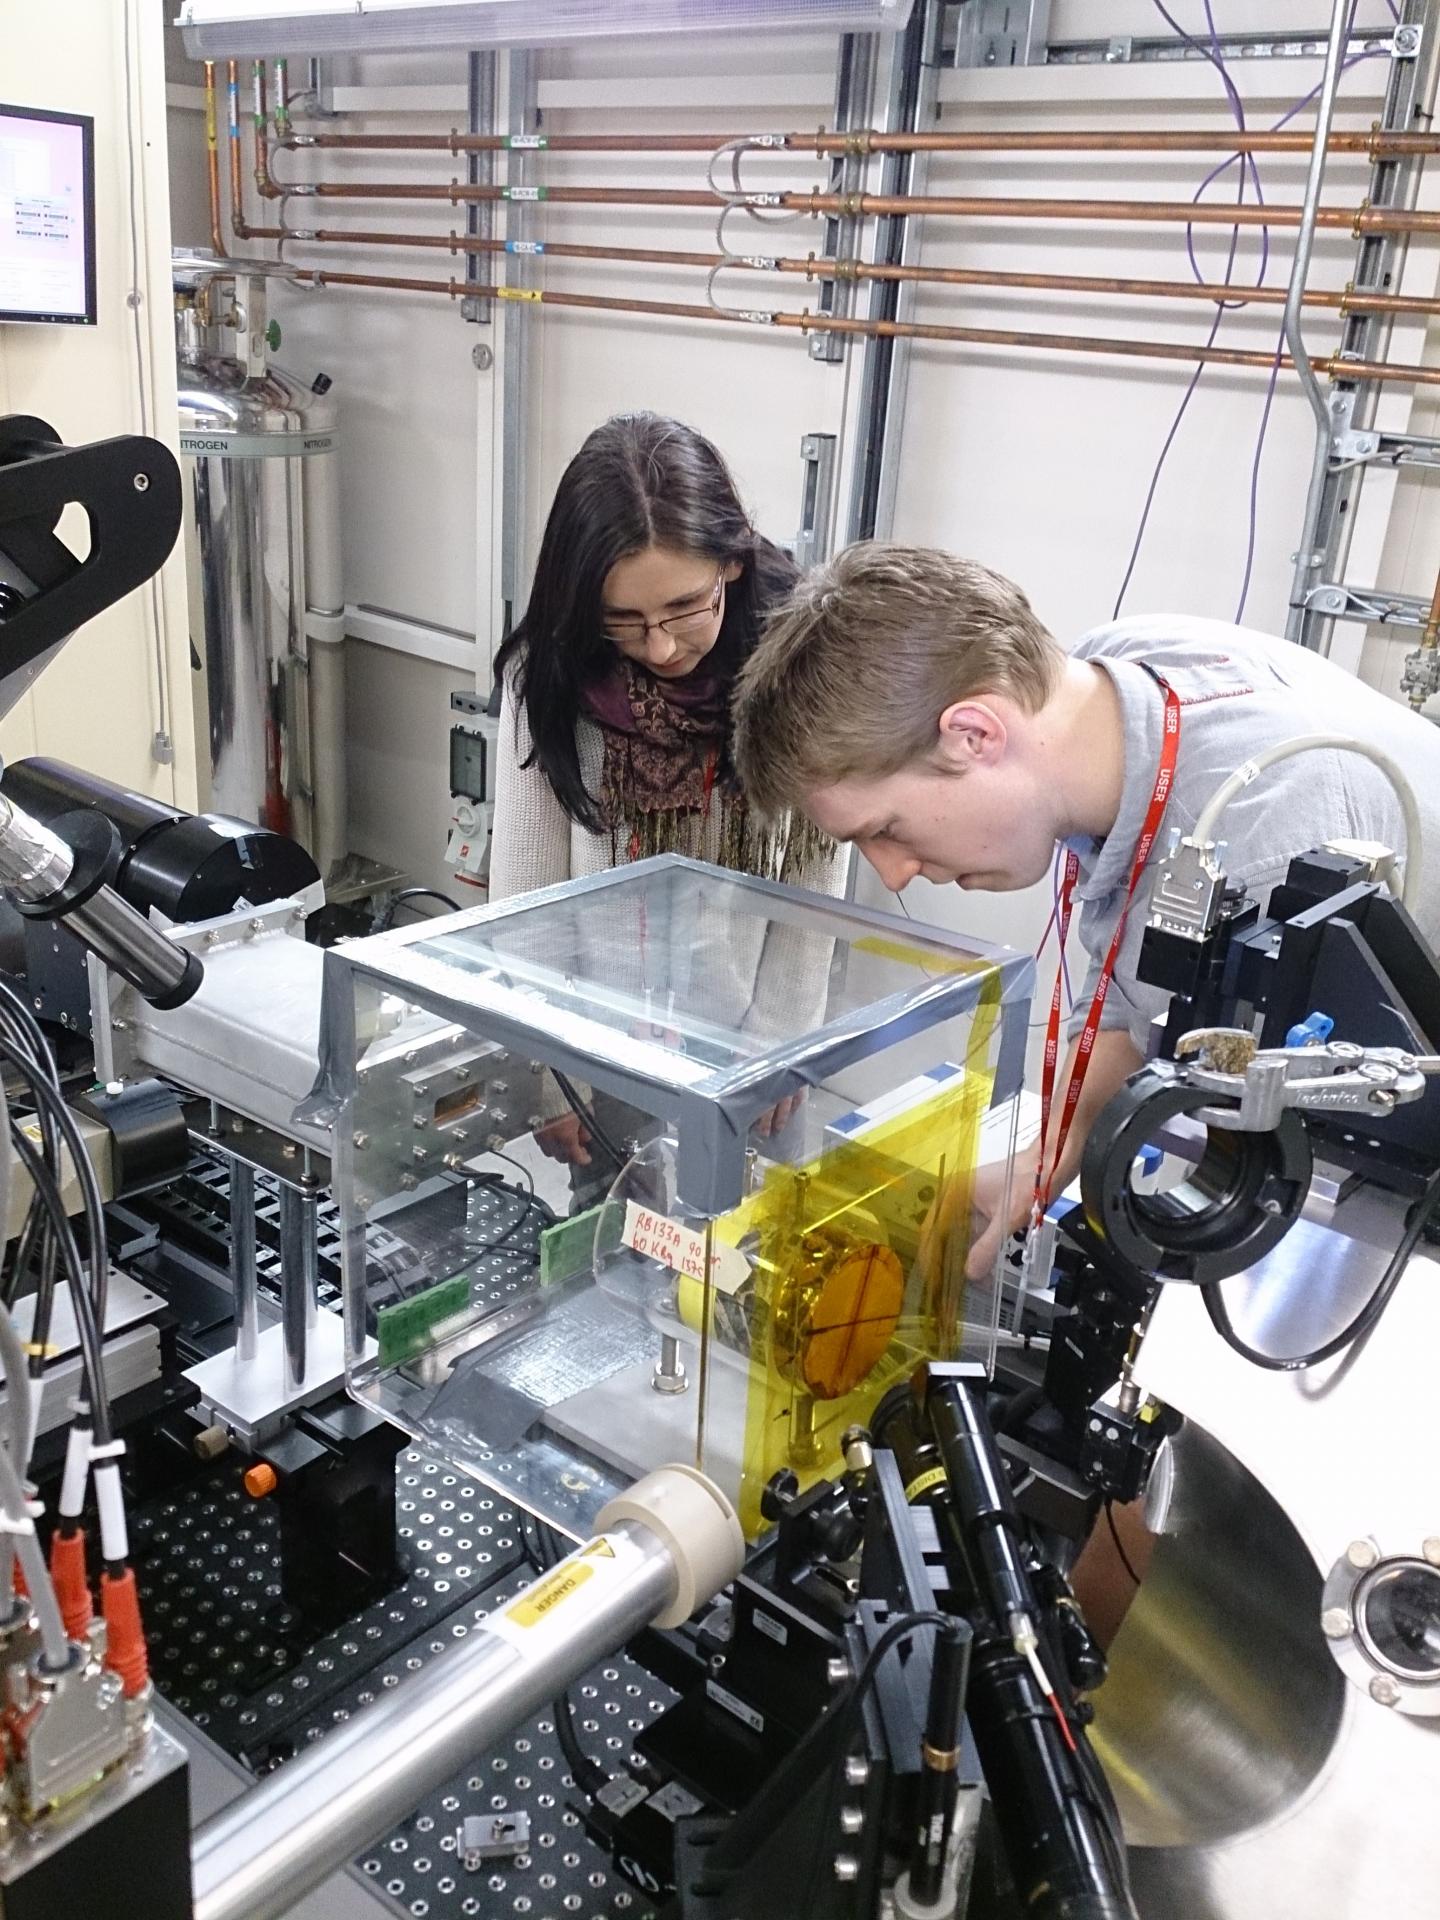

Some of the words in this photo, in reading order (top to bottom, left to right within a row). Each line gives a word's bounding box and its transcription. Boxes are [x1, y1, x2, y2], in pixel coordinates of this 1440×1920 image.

[180, 439, 228, 450] ITROGEN
[1167, 705, 1177, 734] USER
[1154, 769, 1171, 802] USER
[1136, 834, 1152, 864] USER
[1067, 853, 1077, 881] USER
[1052, 983, 1061, 1011] USER
[1096, 973, 1109, 1002] USER
[1046, 1039, 1056, 1068] USER
[1080, 1026, 1095, 1054] USER
[1068, 1079, 1081, 1104] USER
[535, 1578, 577, 1613] DANGER
